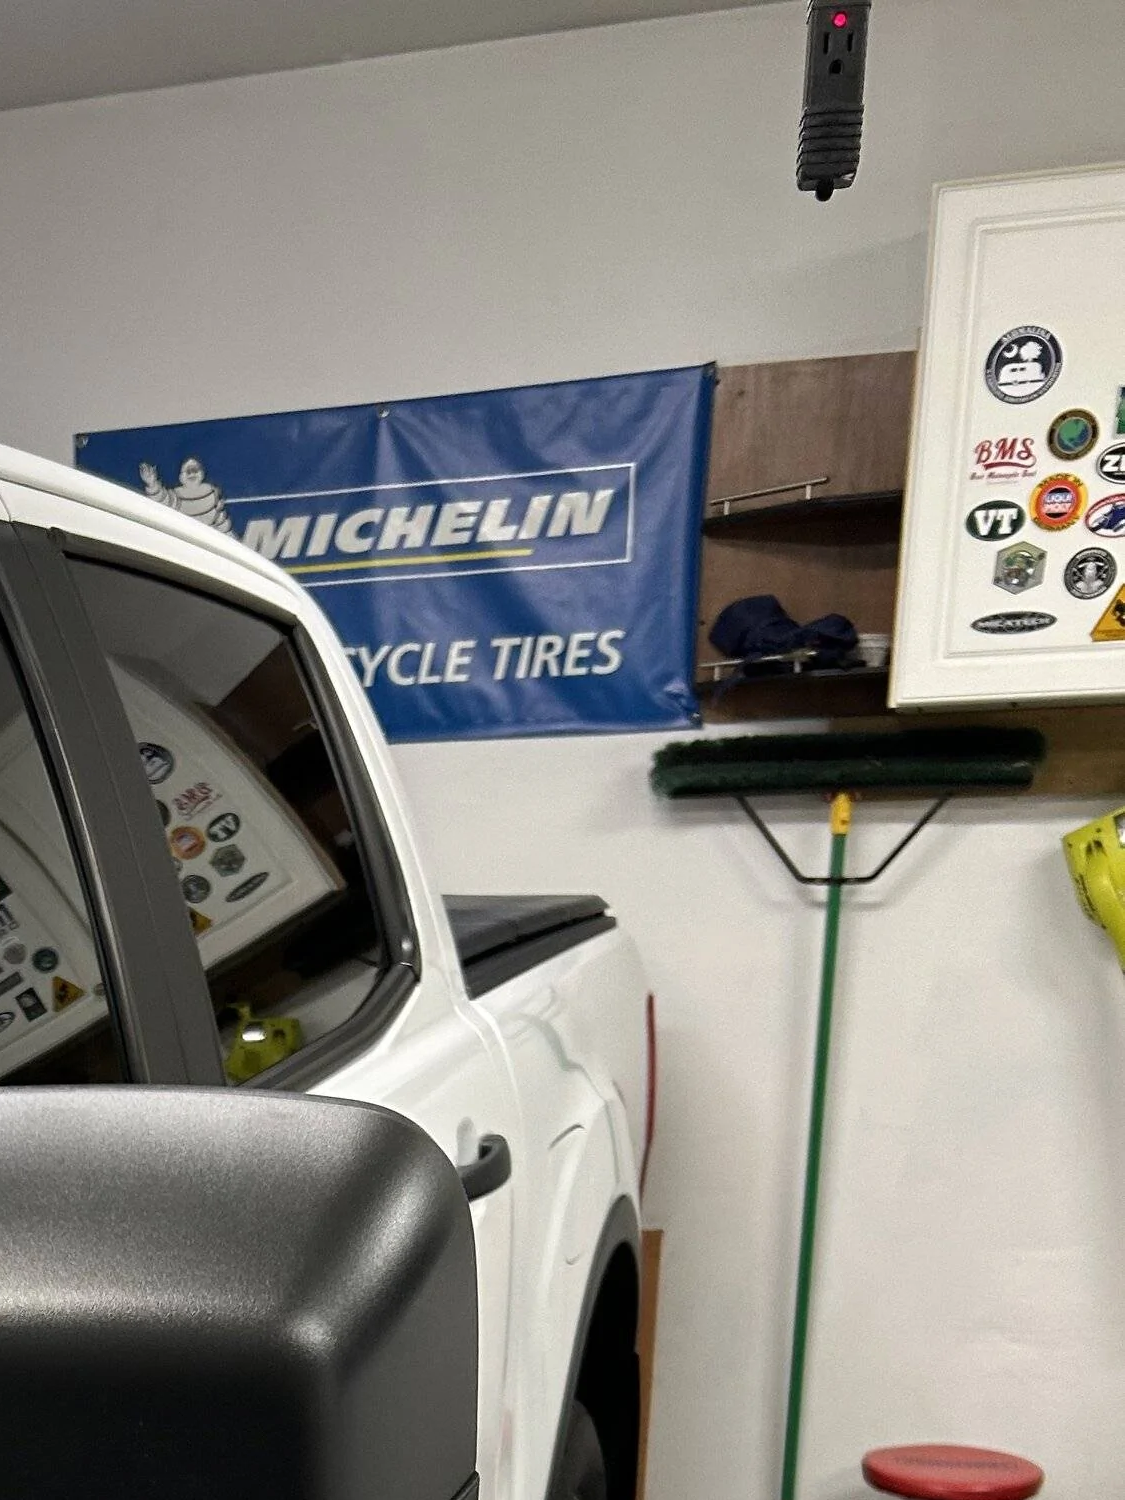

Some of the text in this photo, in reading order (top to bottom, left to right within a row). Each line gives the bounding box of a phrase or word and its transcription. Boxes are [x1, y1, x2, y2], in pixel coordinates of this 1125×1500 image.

[975, 437, 1036, 466] BMS
[241, 489, 615, 560] MICHELIN
[974, 508, 1019, 536] VT
[490, 629, 627, 681] TIRES
